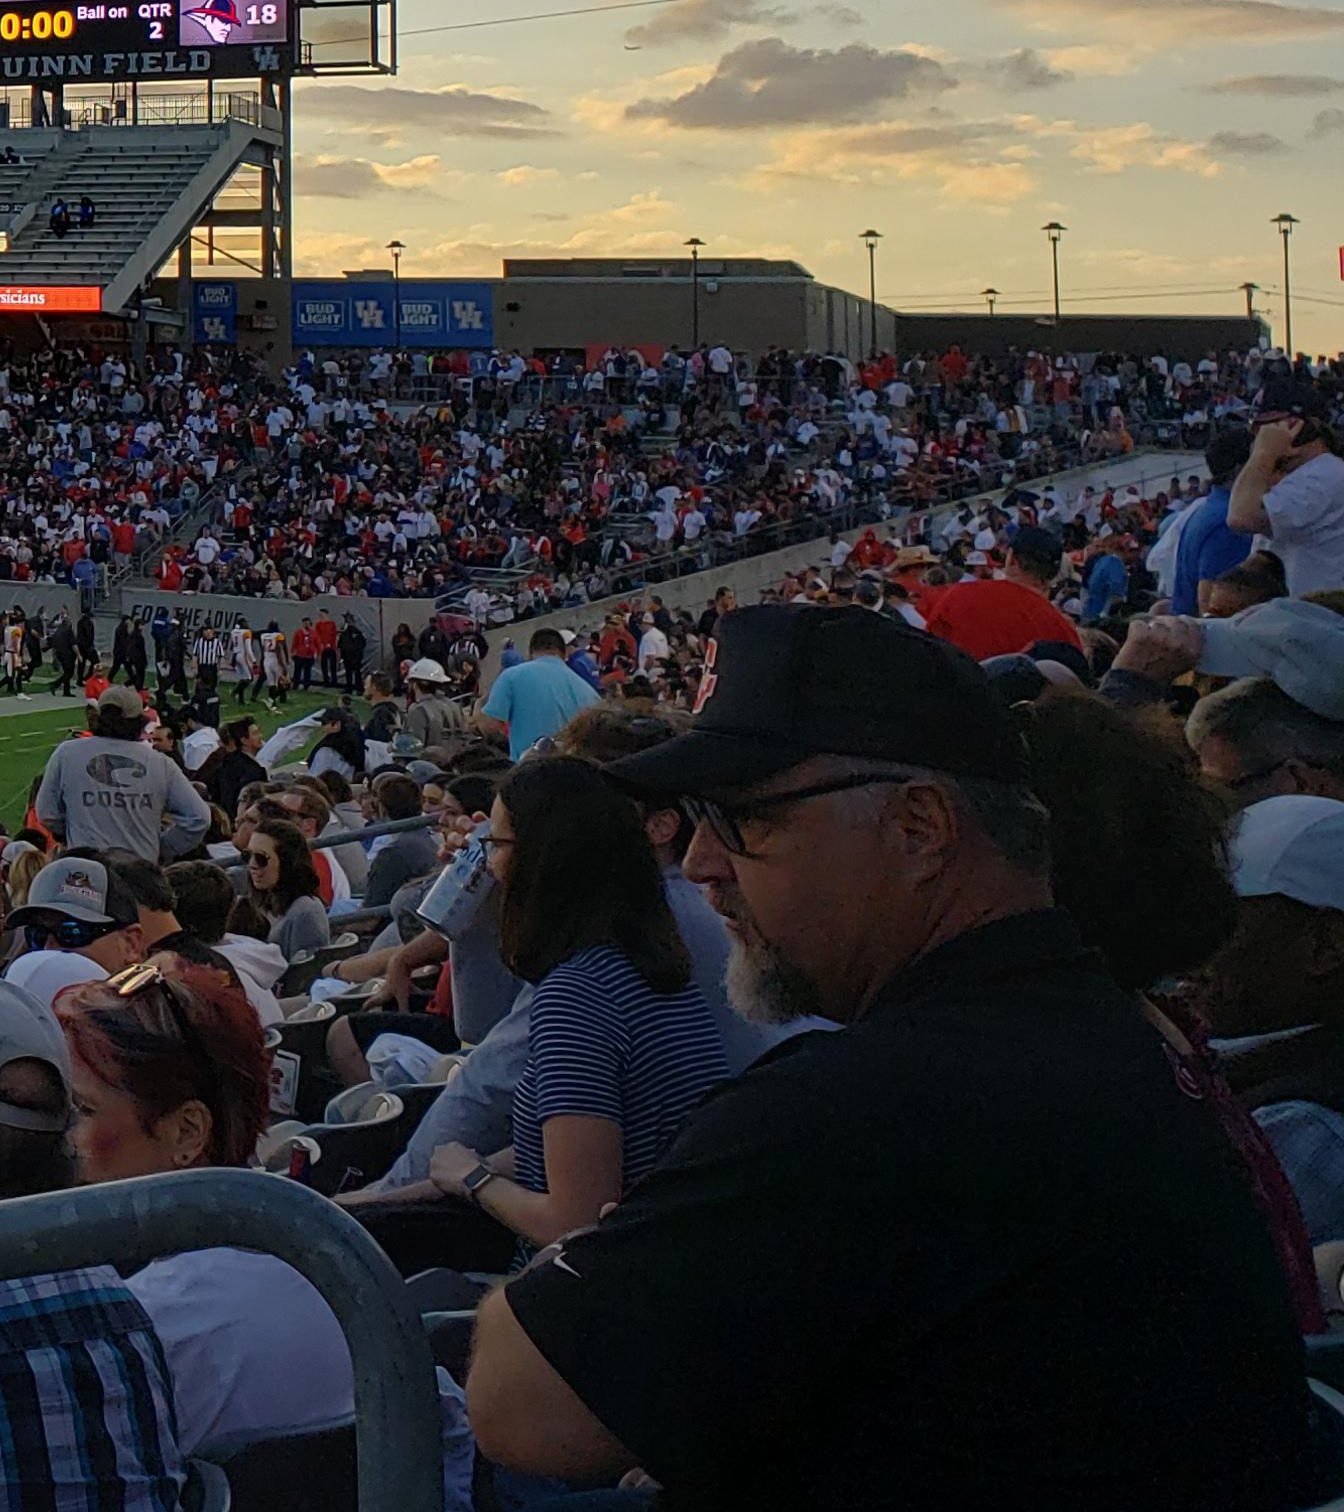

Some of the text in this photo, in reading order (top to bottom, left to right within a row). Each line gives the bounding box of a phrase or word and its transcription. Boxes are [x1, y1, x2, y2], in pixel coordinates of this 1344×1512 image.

[76, 5, 127, 20] Ball on
[138, 3, 171, 19] QTR
[246, 5, 277, 25] 18
[150, 22, 163, 39] 2
[104, 50, 212, 75] FIELD
[305, 303, 334, 315] BUD
[402, 303, 433, 315] BUD
[300, 313, 342, 326] LIGHT
[82, 791, 153, 809] COSTA
